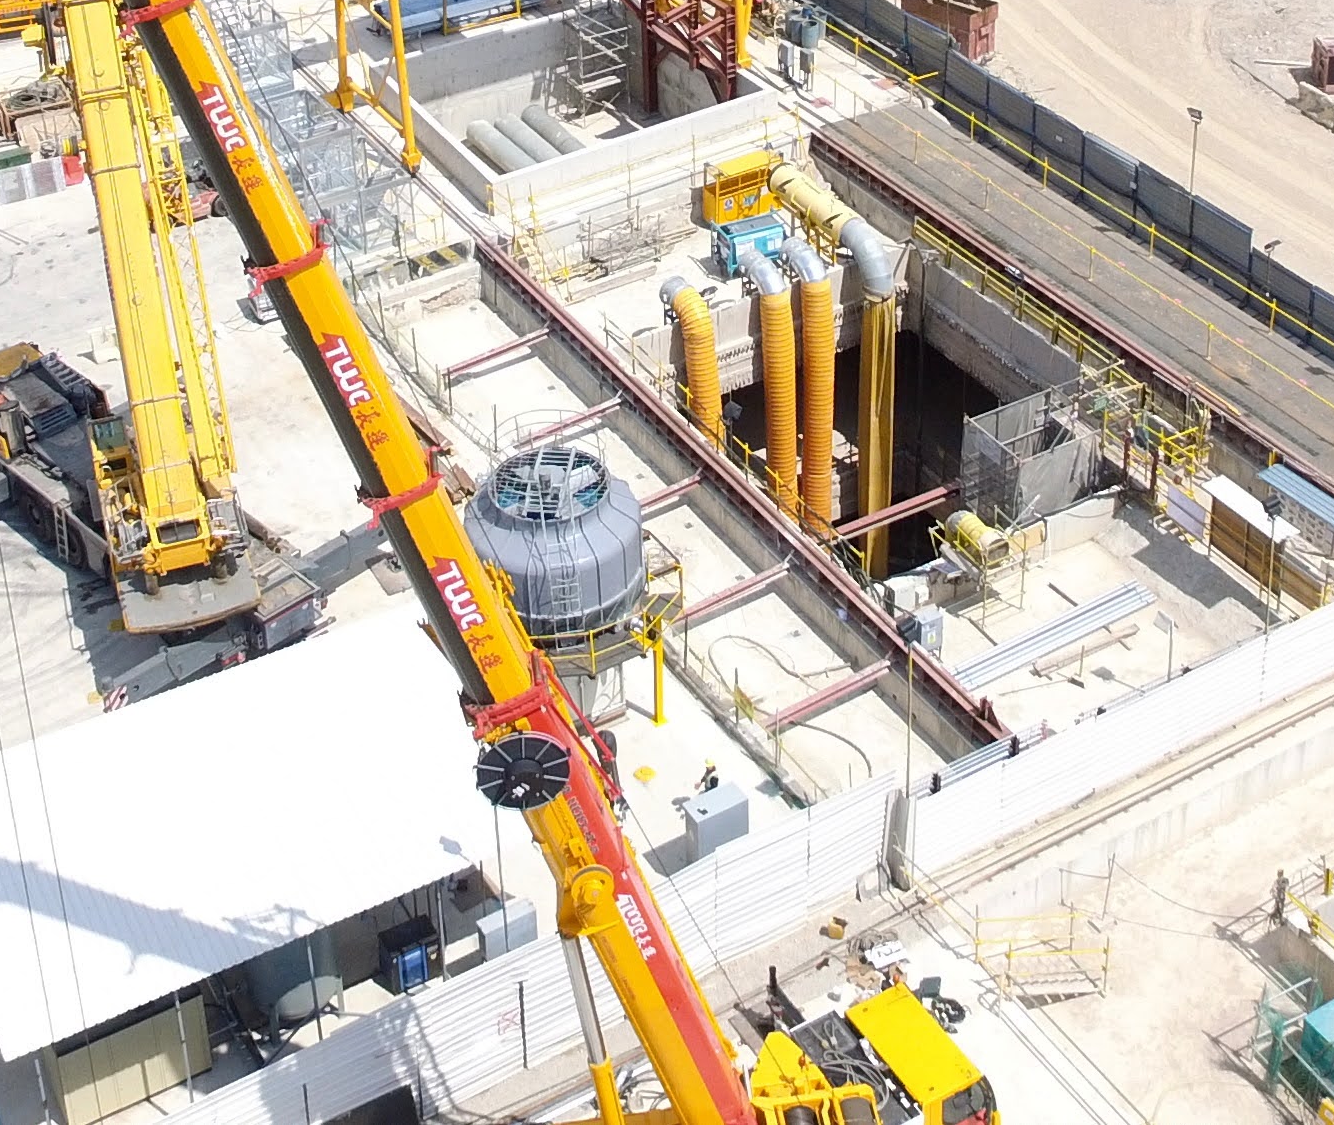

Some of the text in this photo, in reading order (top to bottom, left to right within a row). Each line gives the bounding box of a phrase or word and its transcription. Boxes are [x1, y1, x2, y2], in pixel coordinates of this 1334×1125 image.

[202, 86, 246, 152] TWC
[325, 337, 371, 406] TWC
[436, 561, 484, 630] TWC
[620, 896, 645, 935] TWC
